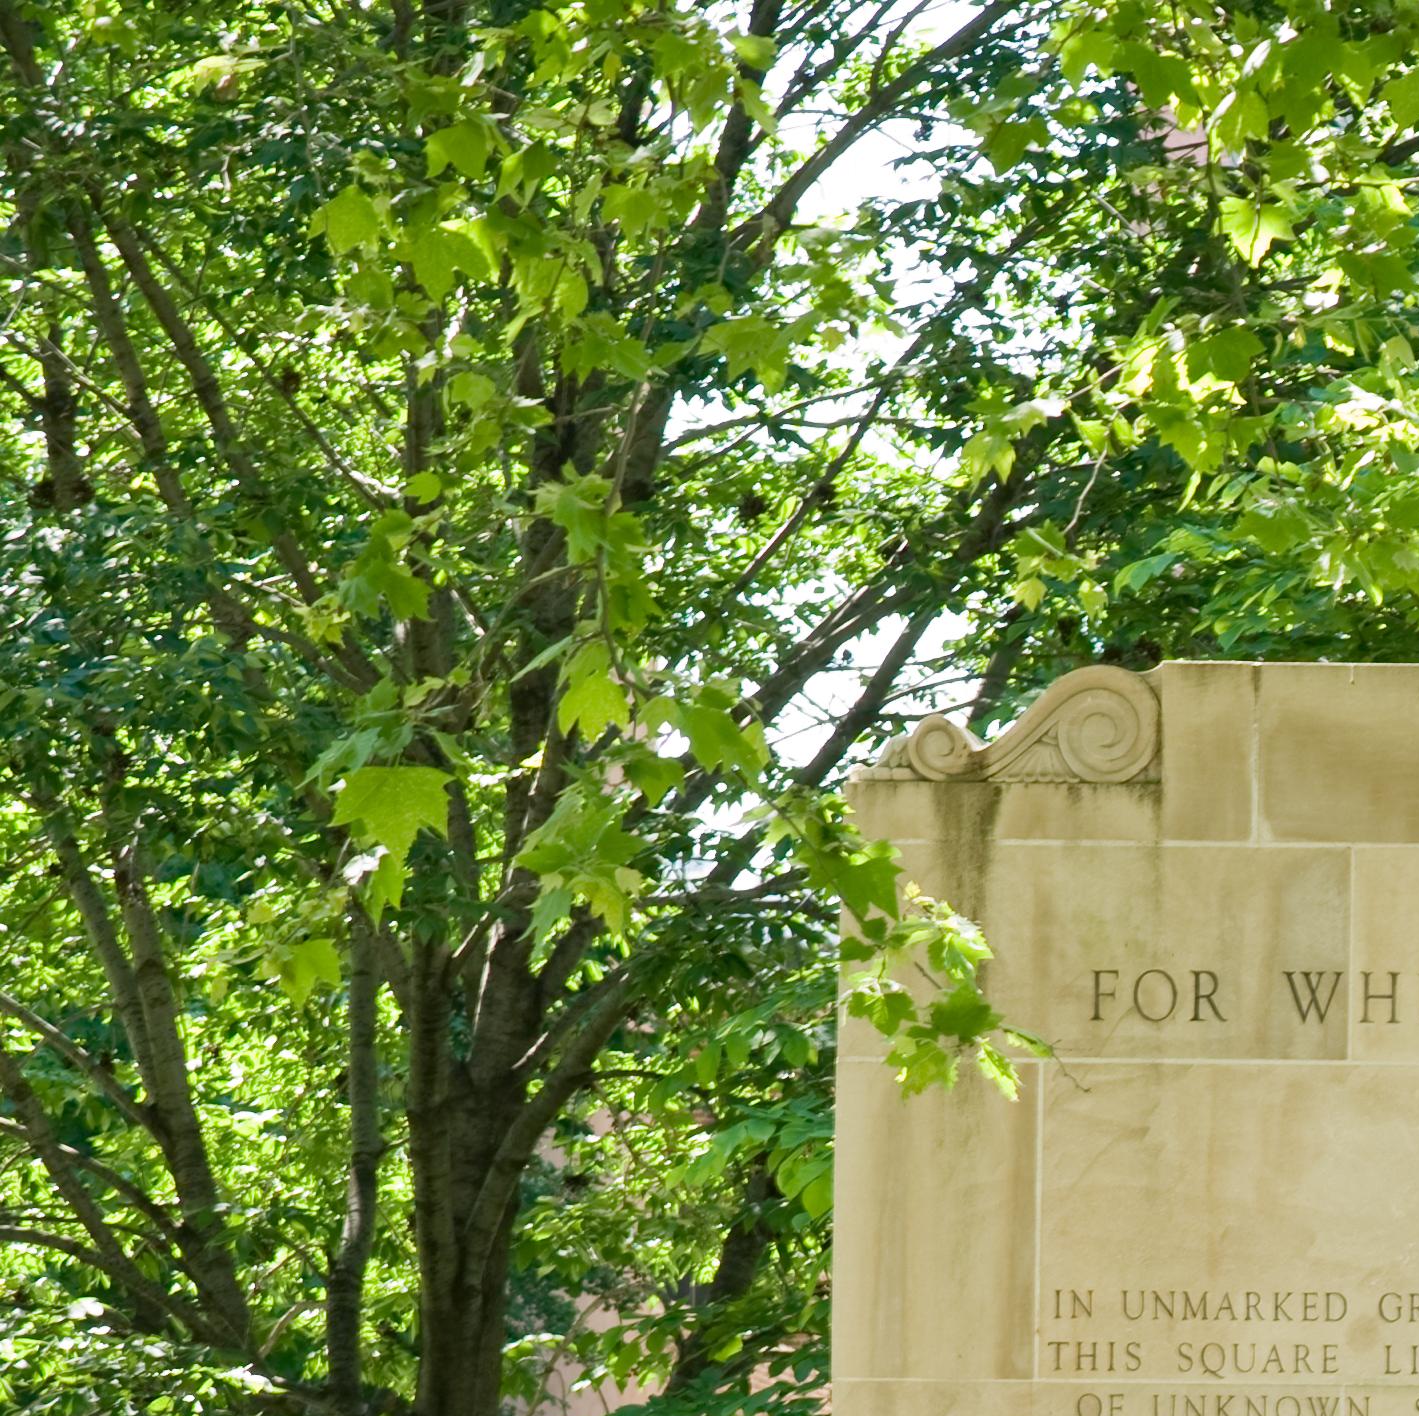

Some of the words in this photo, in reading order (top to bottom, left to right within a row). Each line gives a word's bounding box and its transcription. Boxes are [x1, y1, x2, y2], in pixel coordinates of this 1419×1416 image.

[1090, 969, 1227, 1024] FOR
[1054, 1289, 1093, 1319] IN
[1121, 1290, 1347, 1322] UNMARKED
[1047, 1341, 1141, 1372] THIS
[1177, 1342, 1338, 1379] SQUARE
